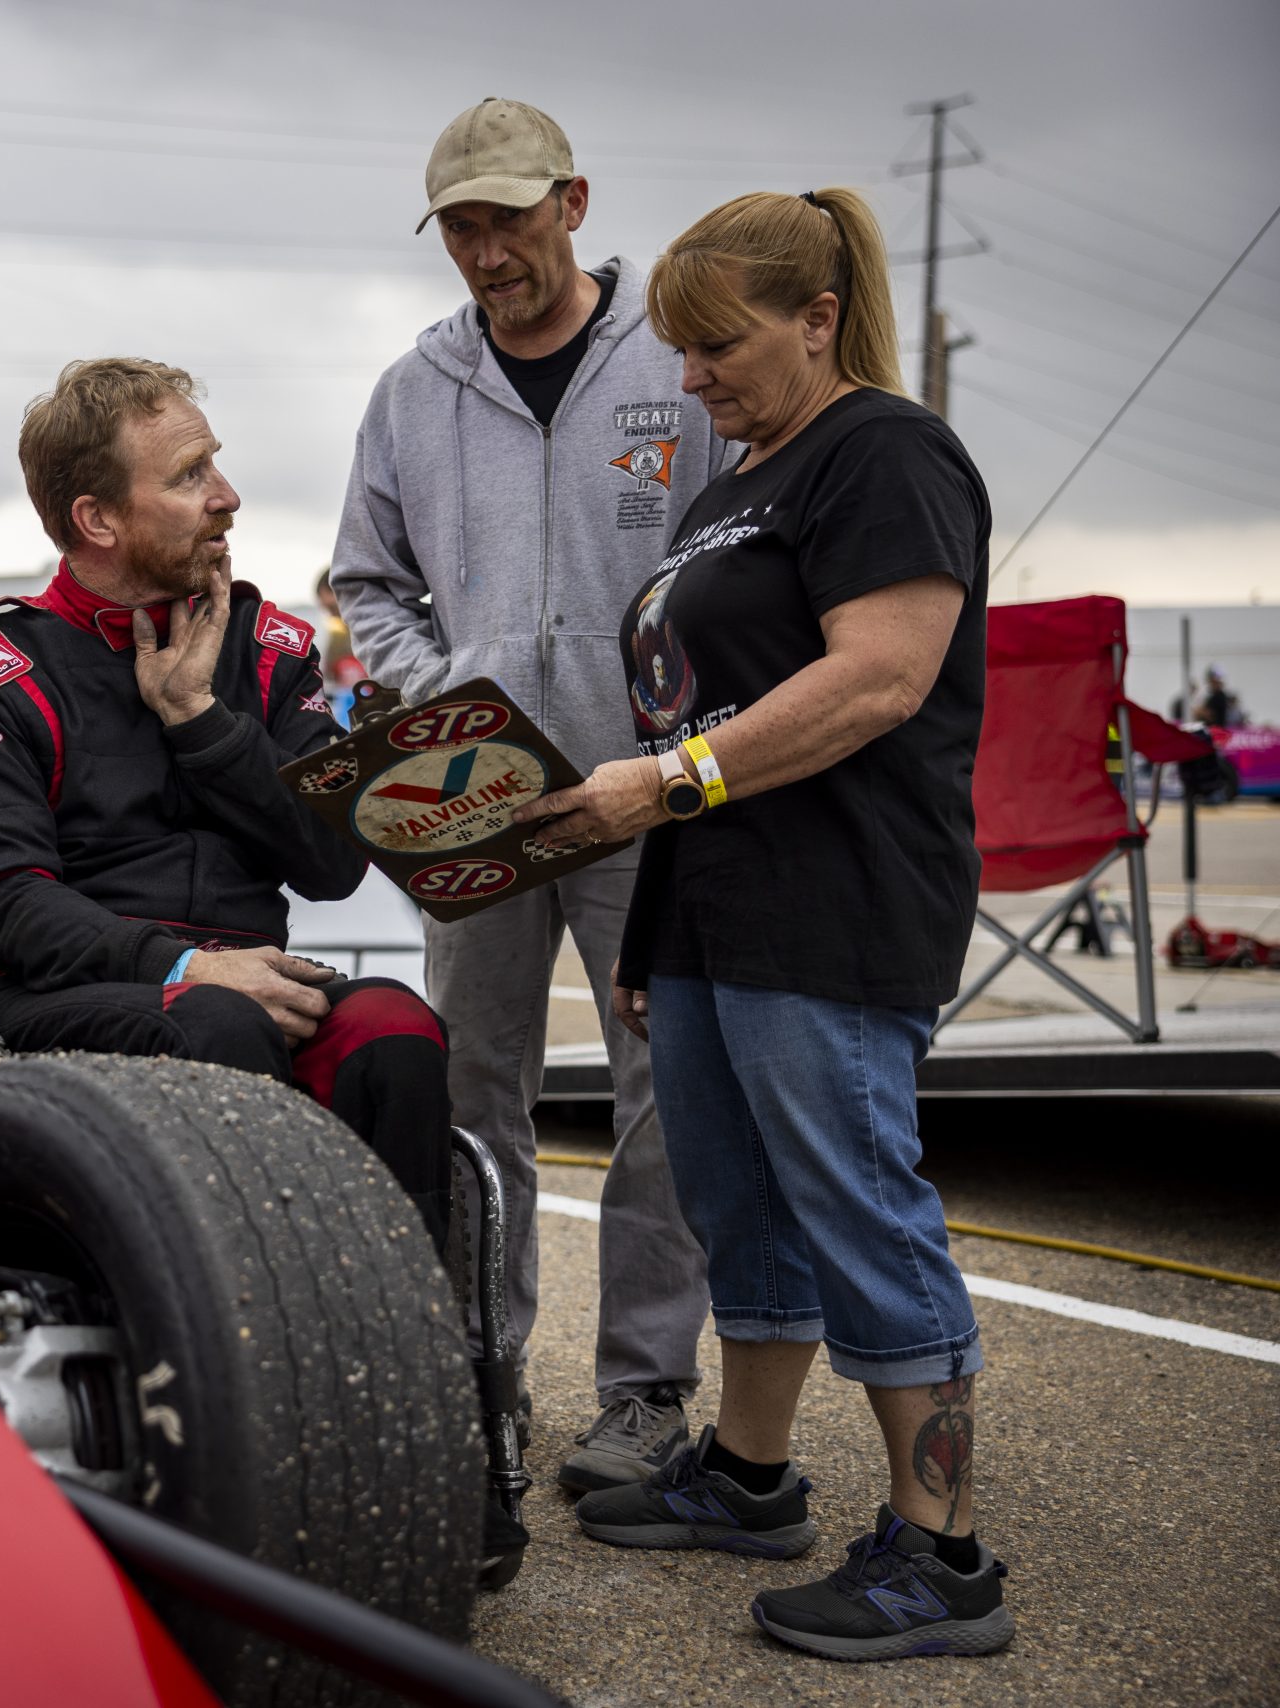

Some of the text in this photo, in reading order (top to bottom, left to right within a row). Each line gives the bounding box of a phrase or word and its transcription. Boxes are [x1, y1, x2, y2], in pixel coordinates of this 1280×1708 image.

[614, 409, 683, 429] TECATE
[615, 404, 629, 412] LOS
[630, 401, 668, 410] ANCIANOS
[624, 427, 671, 437] ENDURO
[403, 704, 495, 742] STP
[427, 801, 514, 841] RACING OIL
[420, 863, 503, 893] STP
